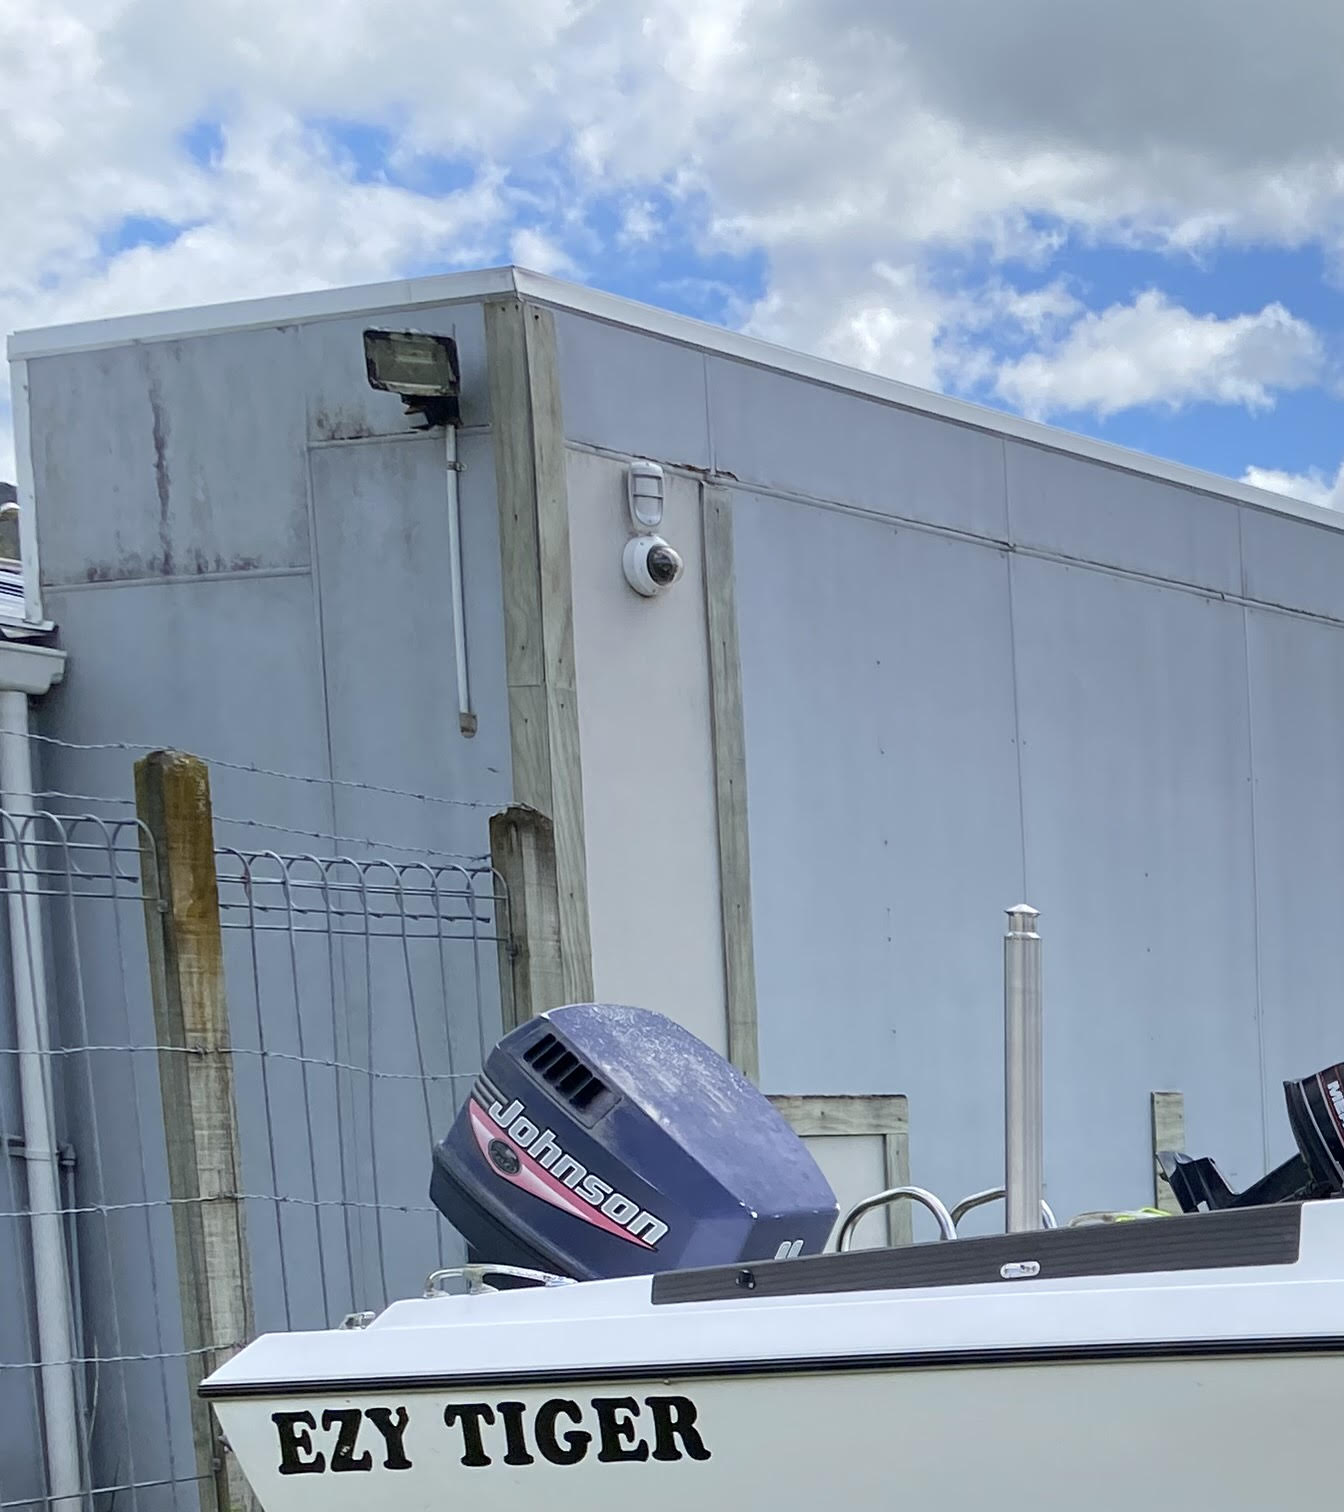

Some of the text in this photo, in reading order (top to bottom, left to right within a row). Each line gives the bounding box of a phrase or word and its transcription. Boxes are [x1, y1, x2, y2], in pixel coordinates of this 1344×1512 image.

[488, 1099, 671, 1247] Johnson
[271, 1396, 712, 1476] EZY TIGER
